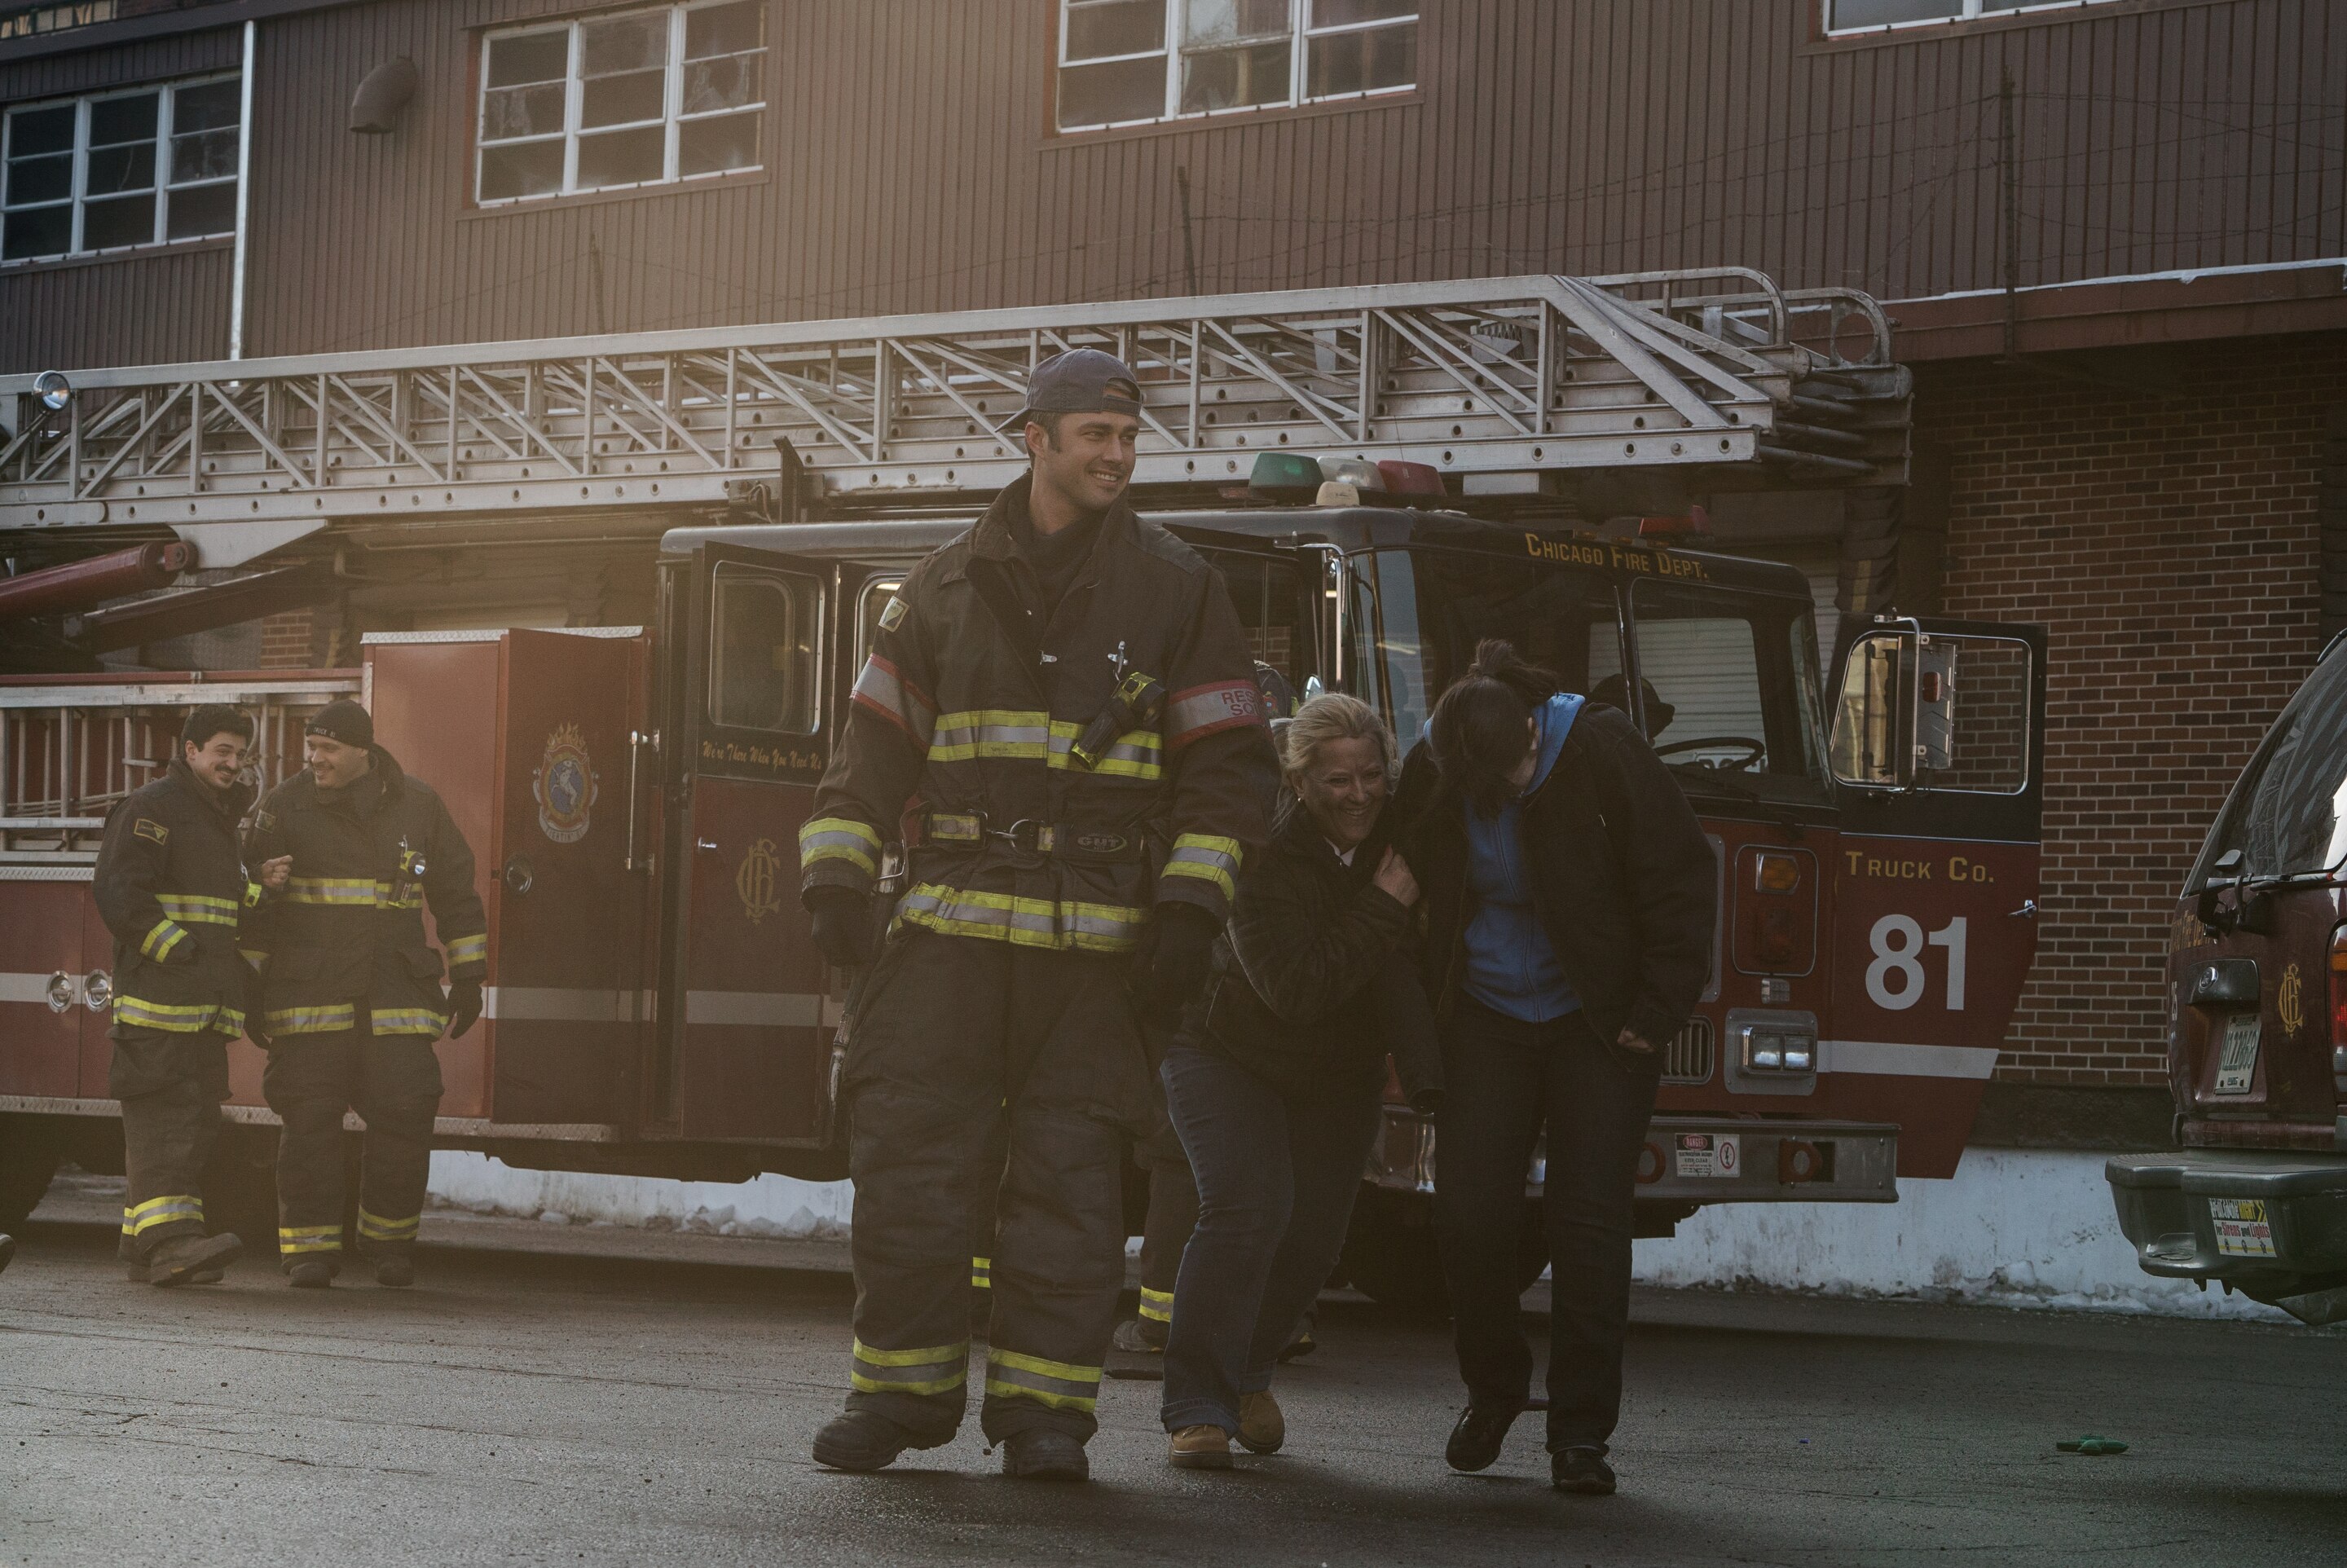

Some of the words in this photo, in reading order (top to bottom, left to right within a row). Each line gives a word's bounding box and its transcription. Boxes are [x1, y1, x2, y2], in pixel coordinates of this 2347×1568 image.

[1525, 533, 1604, 566] CHICAGO
[1610, 546, 1650, 572] FIRE
[1656, 552, 1709, 578] DEPT.
[1845, 850, 1931, 879] TRUCK
[1948, 857, 1994, 883] CO.
[1865, 914, 1967, 1011] 81
[1686, 1137, 1704, 1147] DANGER
[2222, 1222, 2241, 1236] Sirens
[2249, 1223, 2270, 1240] Lights
